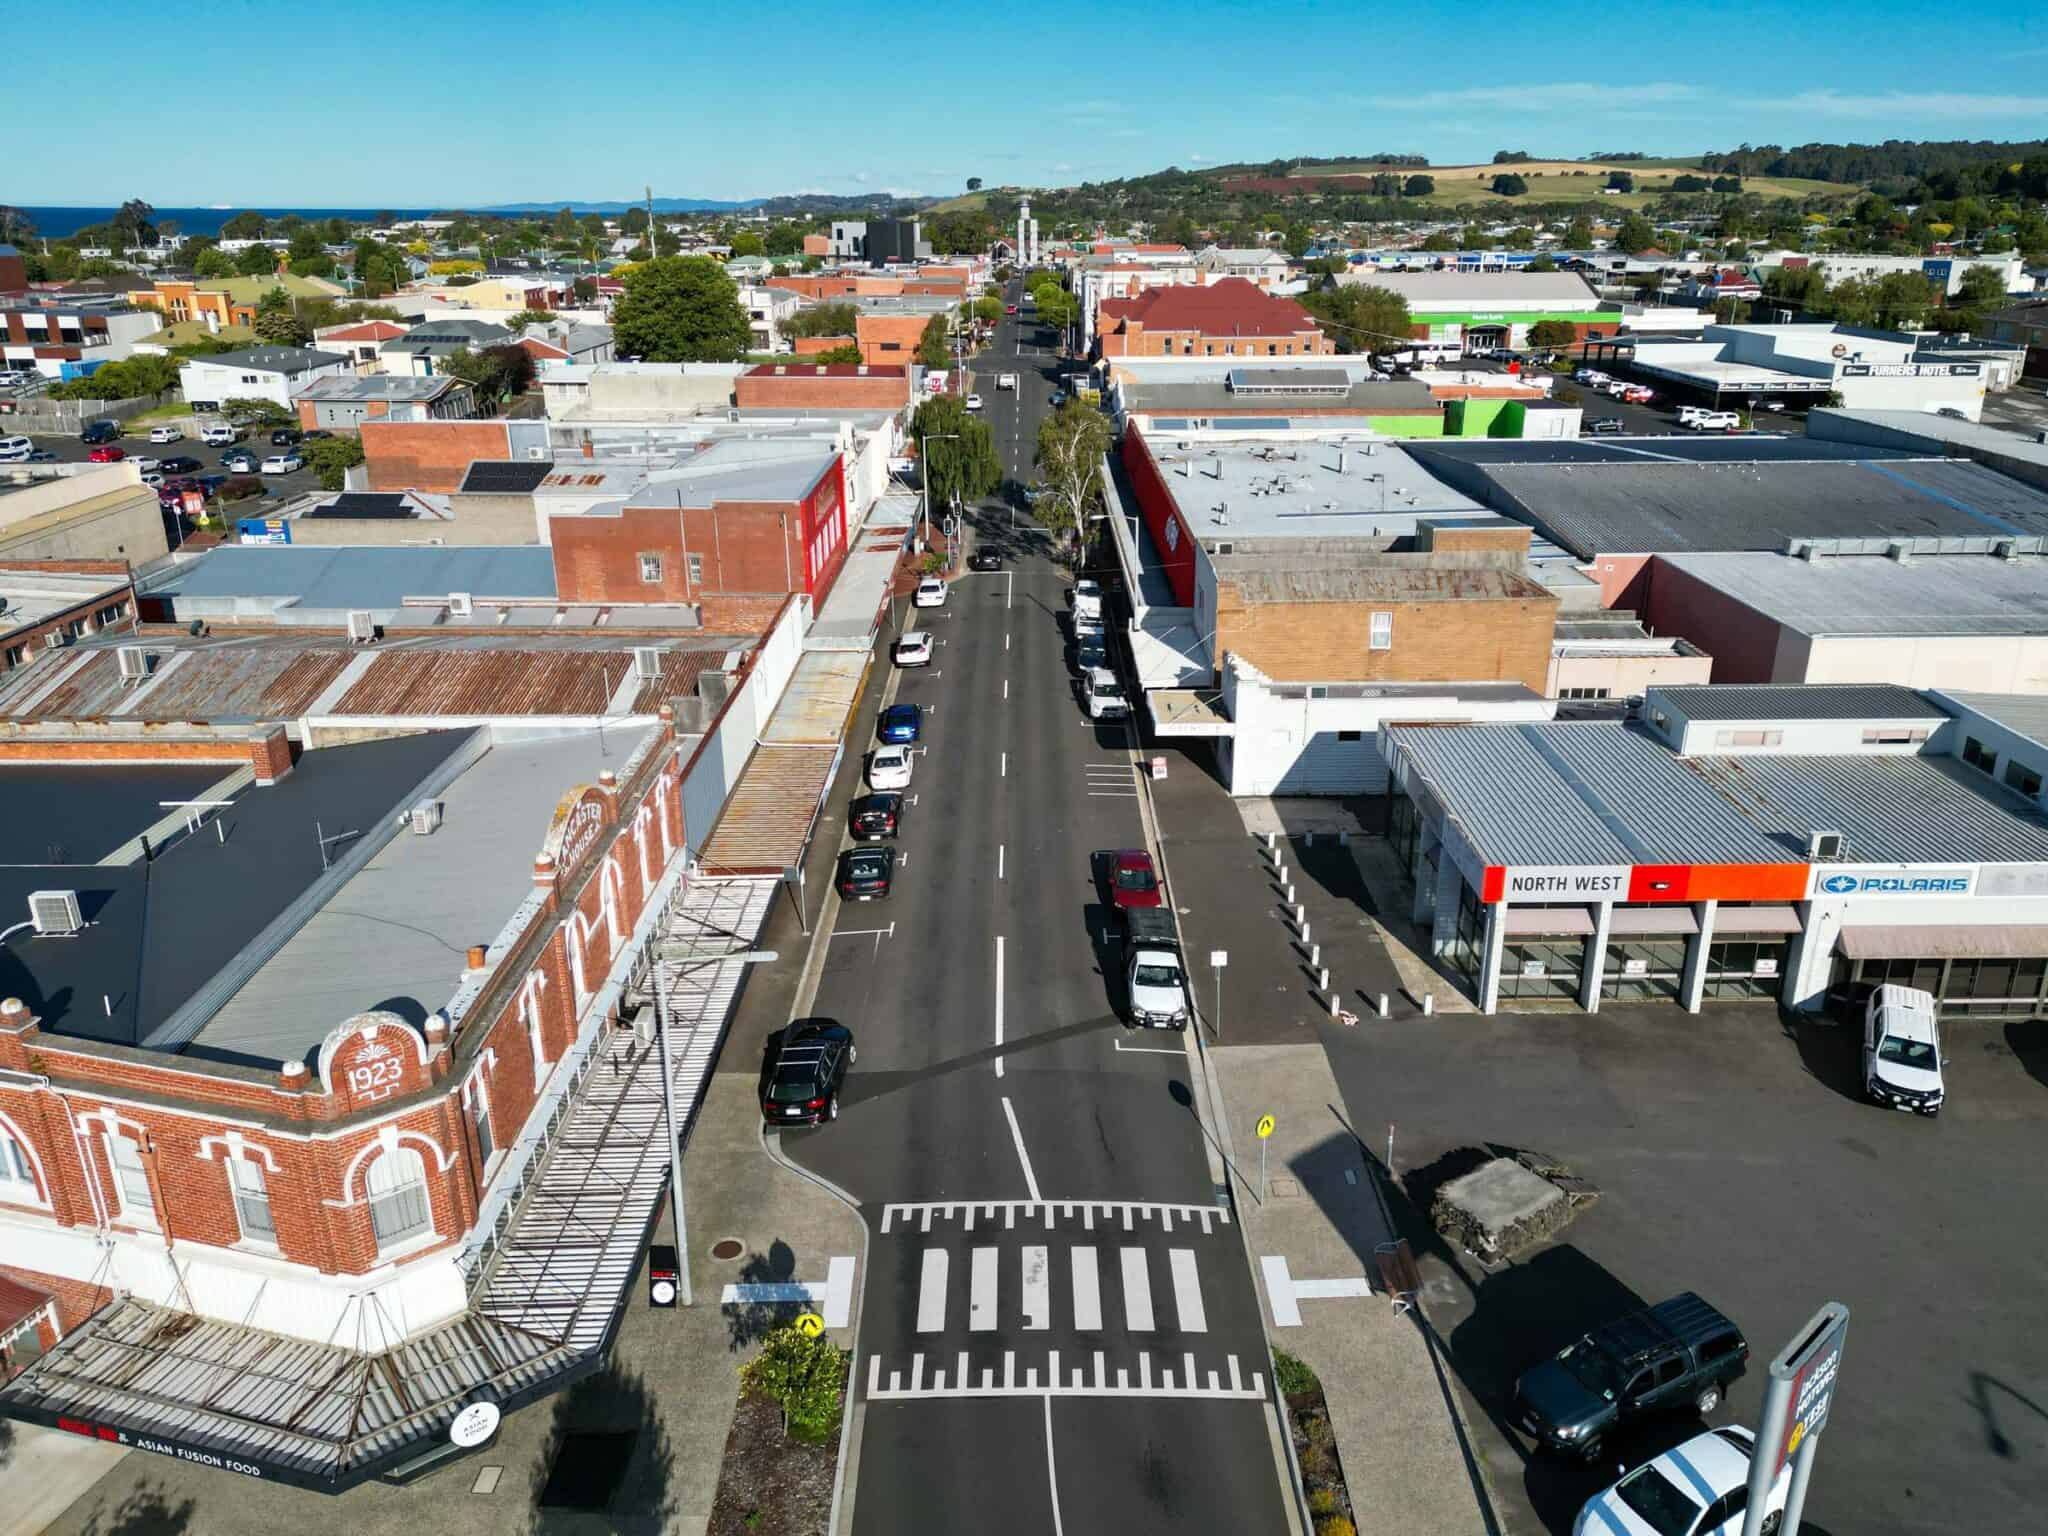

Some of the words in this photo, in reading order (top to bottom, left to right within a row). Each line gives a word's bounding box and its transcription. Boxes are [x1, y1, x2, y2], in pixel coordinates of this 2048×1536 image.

[1868, 364, 1918, 376] FURNERS
[1919, 364, 1952, 376] HOTEL
[569, 823, 595, 865] HOUSE
[1512, 877, 1568, 892] NORTH
[1575, 876, 1624, 891] WEST
[1864, 876, 1969, 893] POLARIS
[347, 1057, 404, 1093] 1923
[136, 1438, 173, 1456] ASIAN
[178, 1447, 221, 1467] FUSION
[226, 1459, 261, 1477] FOOD
